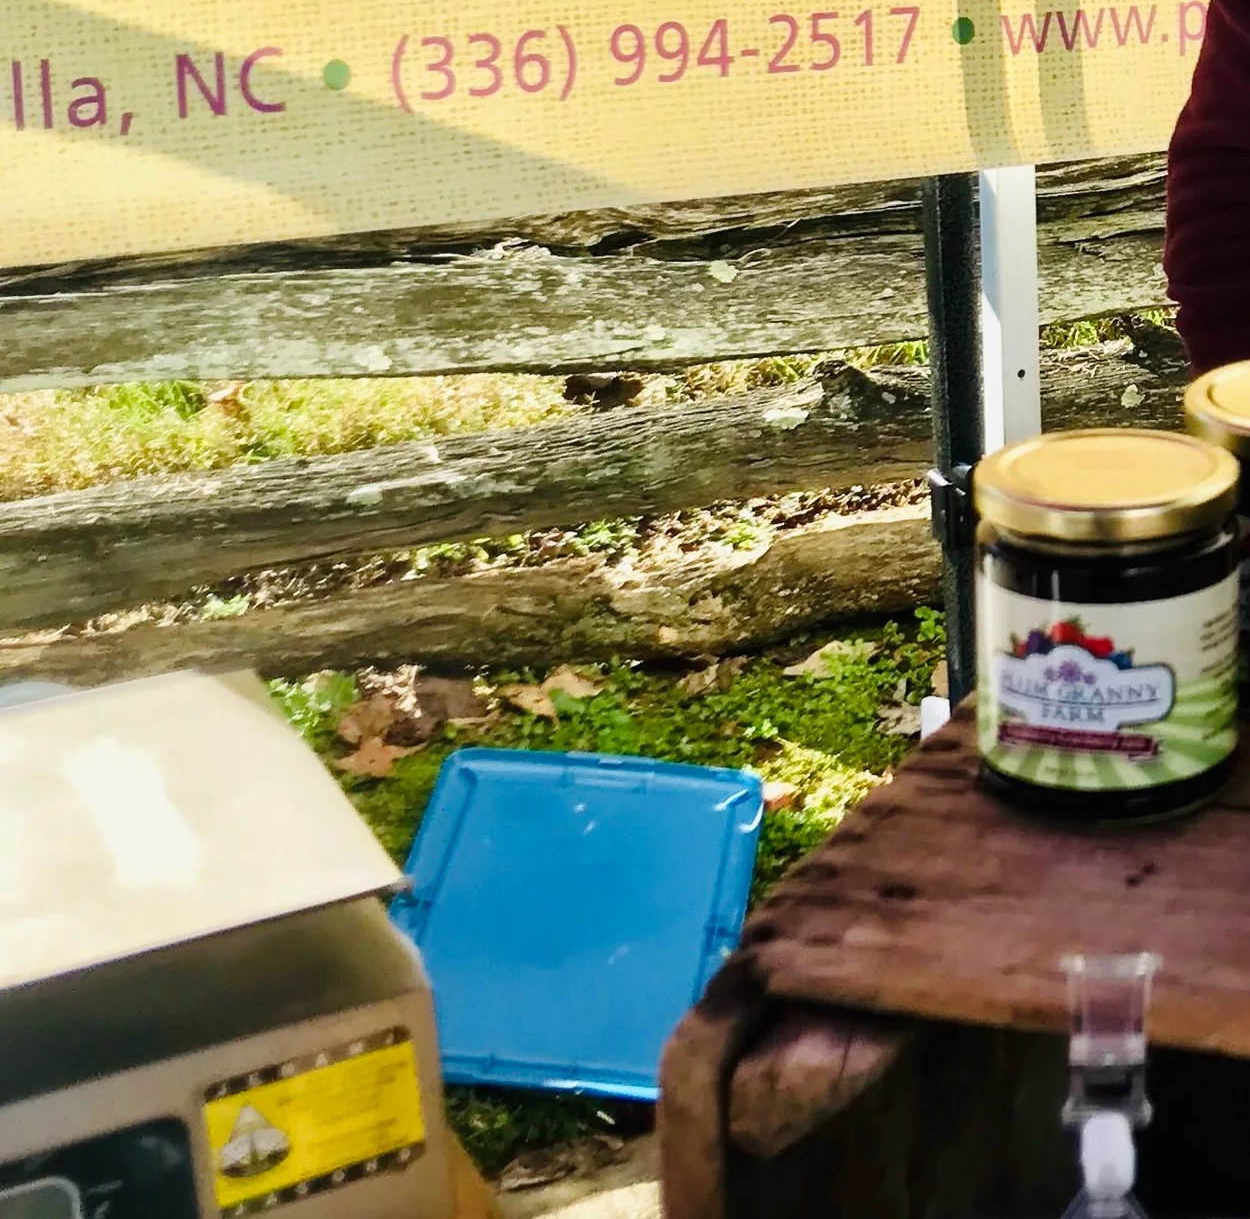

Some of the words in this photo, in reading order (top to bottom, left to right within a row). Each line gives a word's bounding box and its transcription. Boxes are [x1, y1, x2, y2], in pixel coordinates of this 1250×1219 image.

[175, 47, 286, 119] NC
[391, 25, 577, 113] (336)
[611, 6, 921, 88] 994-2517
[1058, 683, 1160, 702] GRANNY
[1041, 705, 1105, 723] FARM
